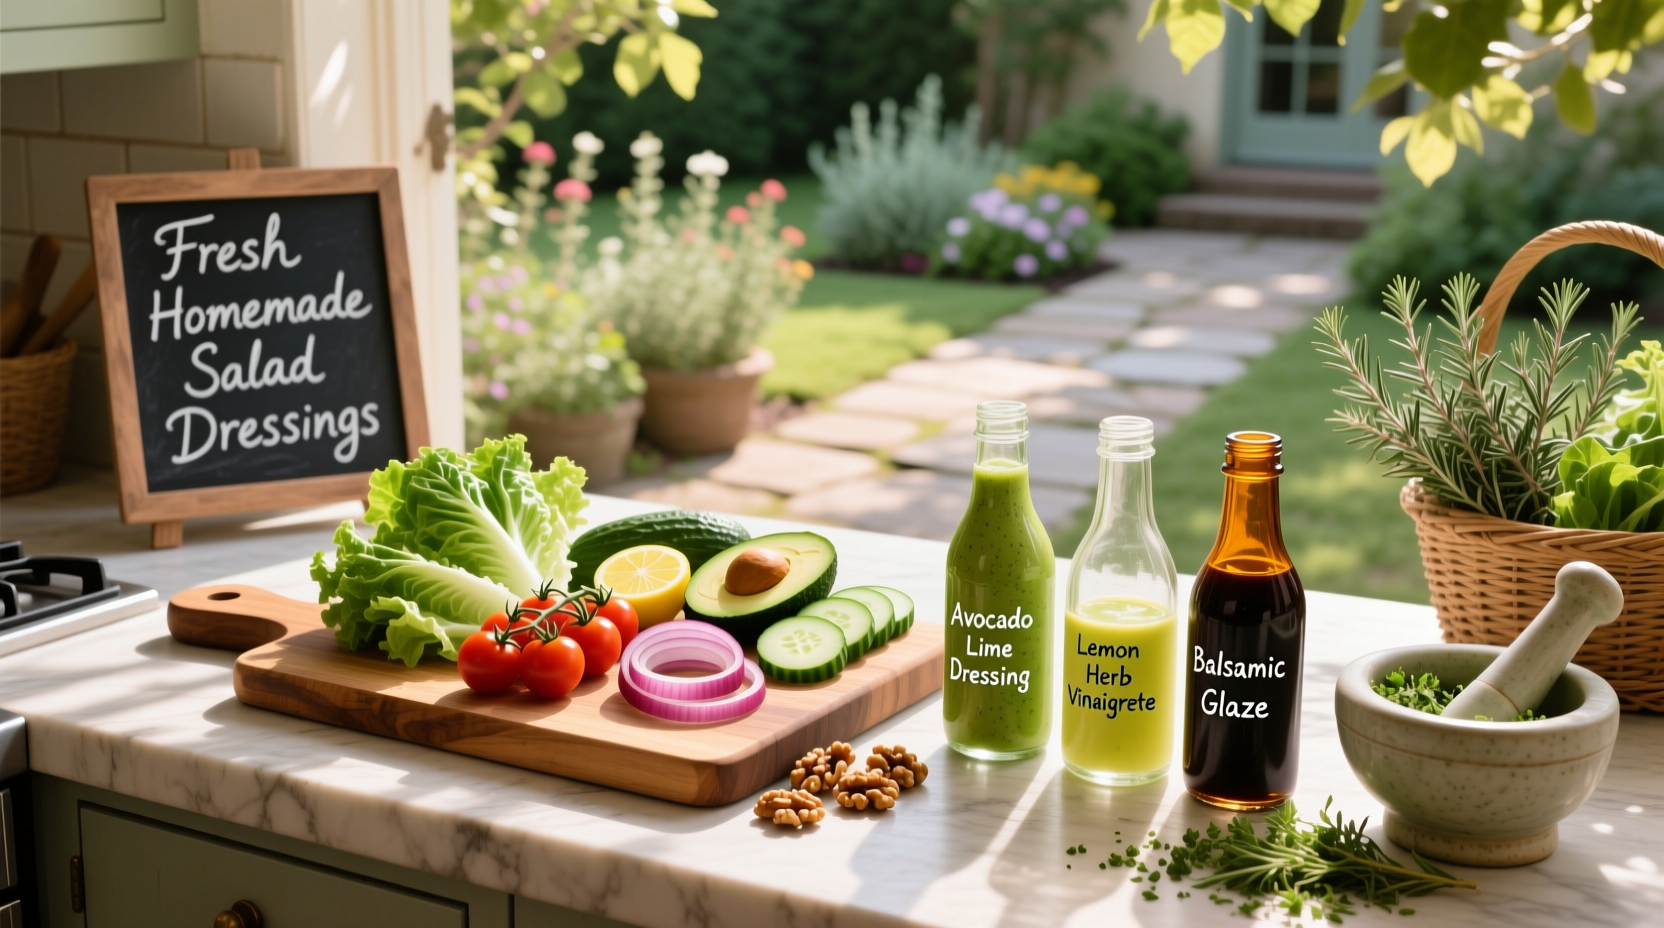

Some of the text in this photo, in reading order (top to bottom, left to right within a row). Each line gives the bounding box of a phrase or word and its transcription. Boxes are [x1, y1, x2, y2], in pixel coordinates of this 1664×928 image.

[154, 212, 302, 281] Fresh
[149, 270, 373, 342] Homemade
[184, 333, 326, 398] Salad
[165, 402, 380, 464] Dressings
[951, 602, 1033, 630] Avocado
[966, 635, 1013, 658] Lime
[1077, 633, 1140, 659] Lemon
[1193, 645, 1286, 679] Balsamic
[950, 657, 1031, 693] Dressing
[1086, 663, 1132, 687] Herb
[1067, 684, 1156, 719] Vinaigrete
[1201, 688, 1269, 719] Glaze
